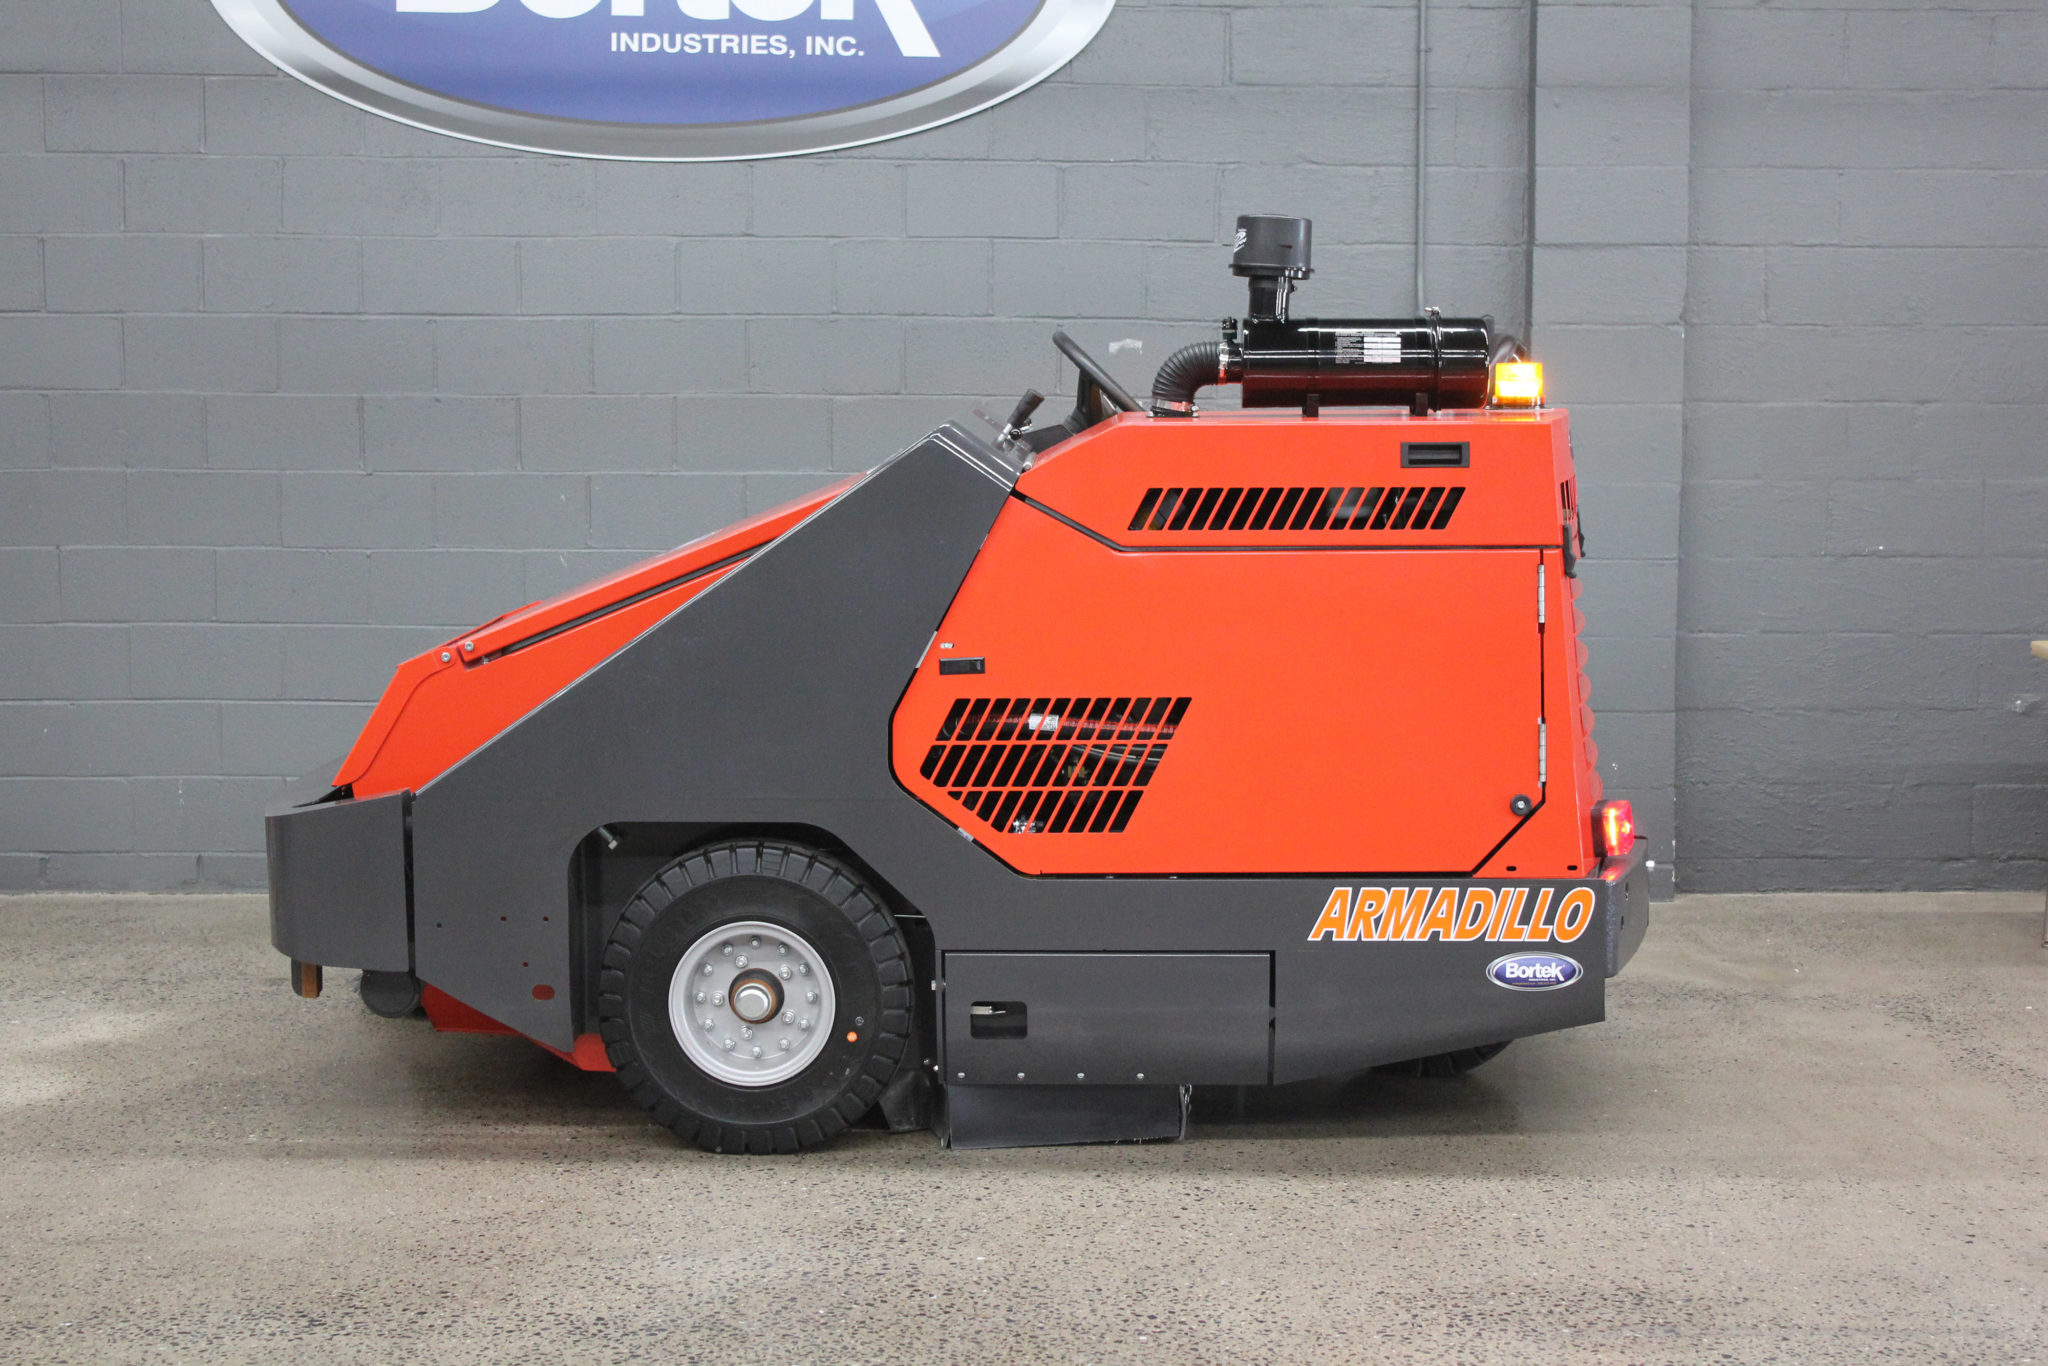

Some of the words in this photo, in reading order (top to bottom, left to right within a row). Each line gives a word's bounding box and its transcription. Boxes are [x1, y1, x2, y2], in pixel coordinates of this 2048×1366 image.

[611, 32, 796, 58] INDUSTRIES,
[805, 36, 865, 56] INC.
[1307, 887, 1595, 943] ARMADILLO
[1505, 962, 1565, 981] Bortek
